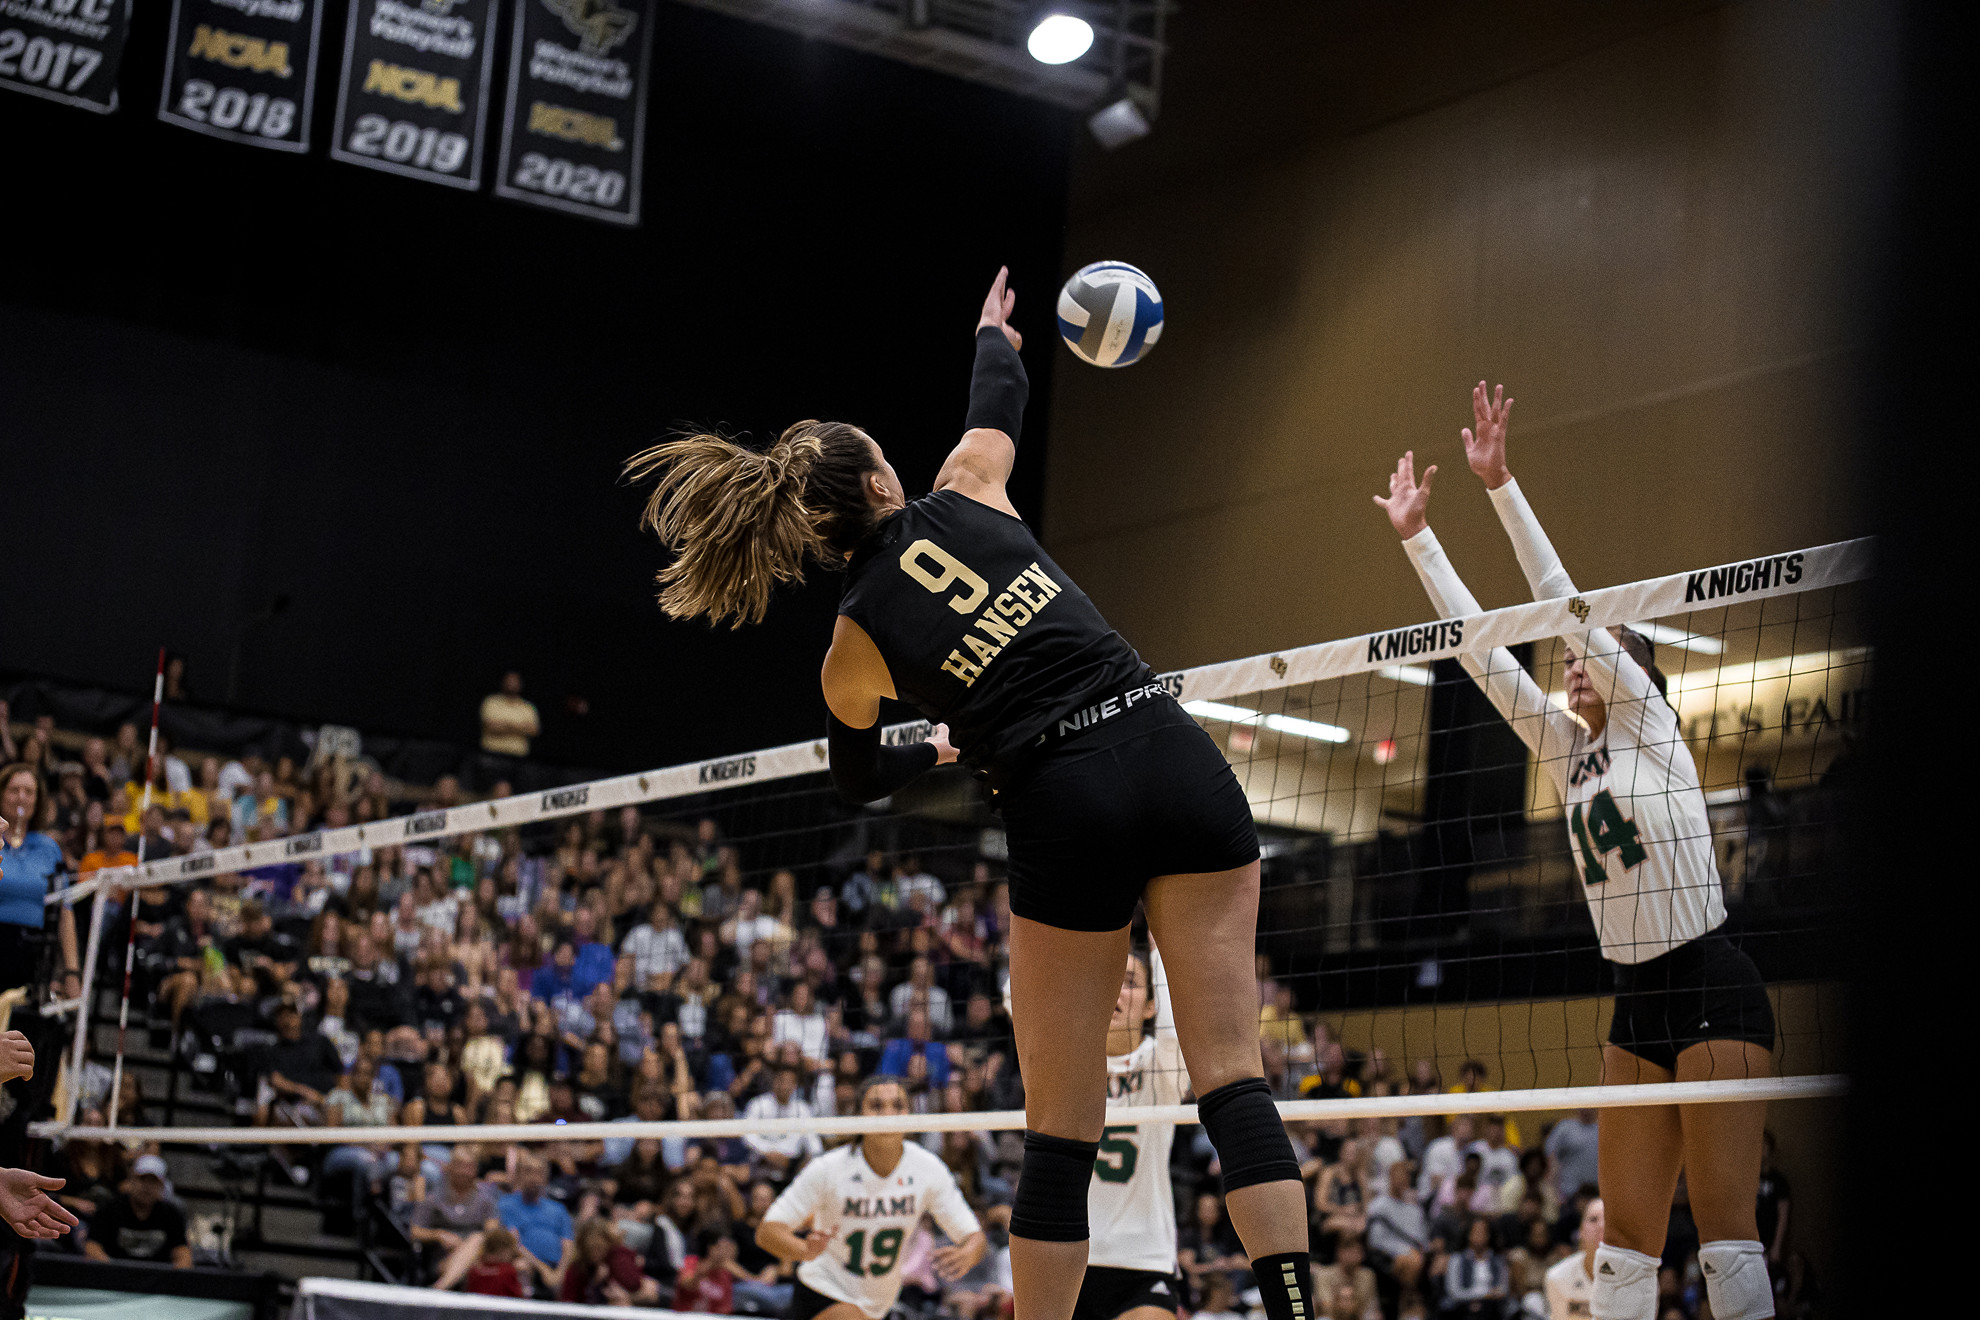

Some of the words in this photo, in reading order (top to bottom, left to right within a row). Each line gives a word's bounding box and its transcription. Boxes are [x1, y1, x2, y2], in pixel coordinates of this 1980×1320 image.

[0, 28, 102, 92] 2017
[180, 79, 296, 138] 2018
[350, 114, 468, 173] 2019
[514, 152, 626, 206] 2020
[900, 539, 989, 615] 9
[1685, 552, 1804, 603] KNIGHTS
[940, 562, 1063, 688] HANSEN
[1568, 597, 1591, 624] UCF
[1367, 619, 1464, 663] KNIGHTS
[699, 756, 757, 784] KNIGHTS
[1570, 788, 1649, 886] 14
[842, 1195, 915, 1218] MIAMI
[844, 1227, 904, 1277] 19
